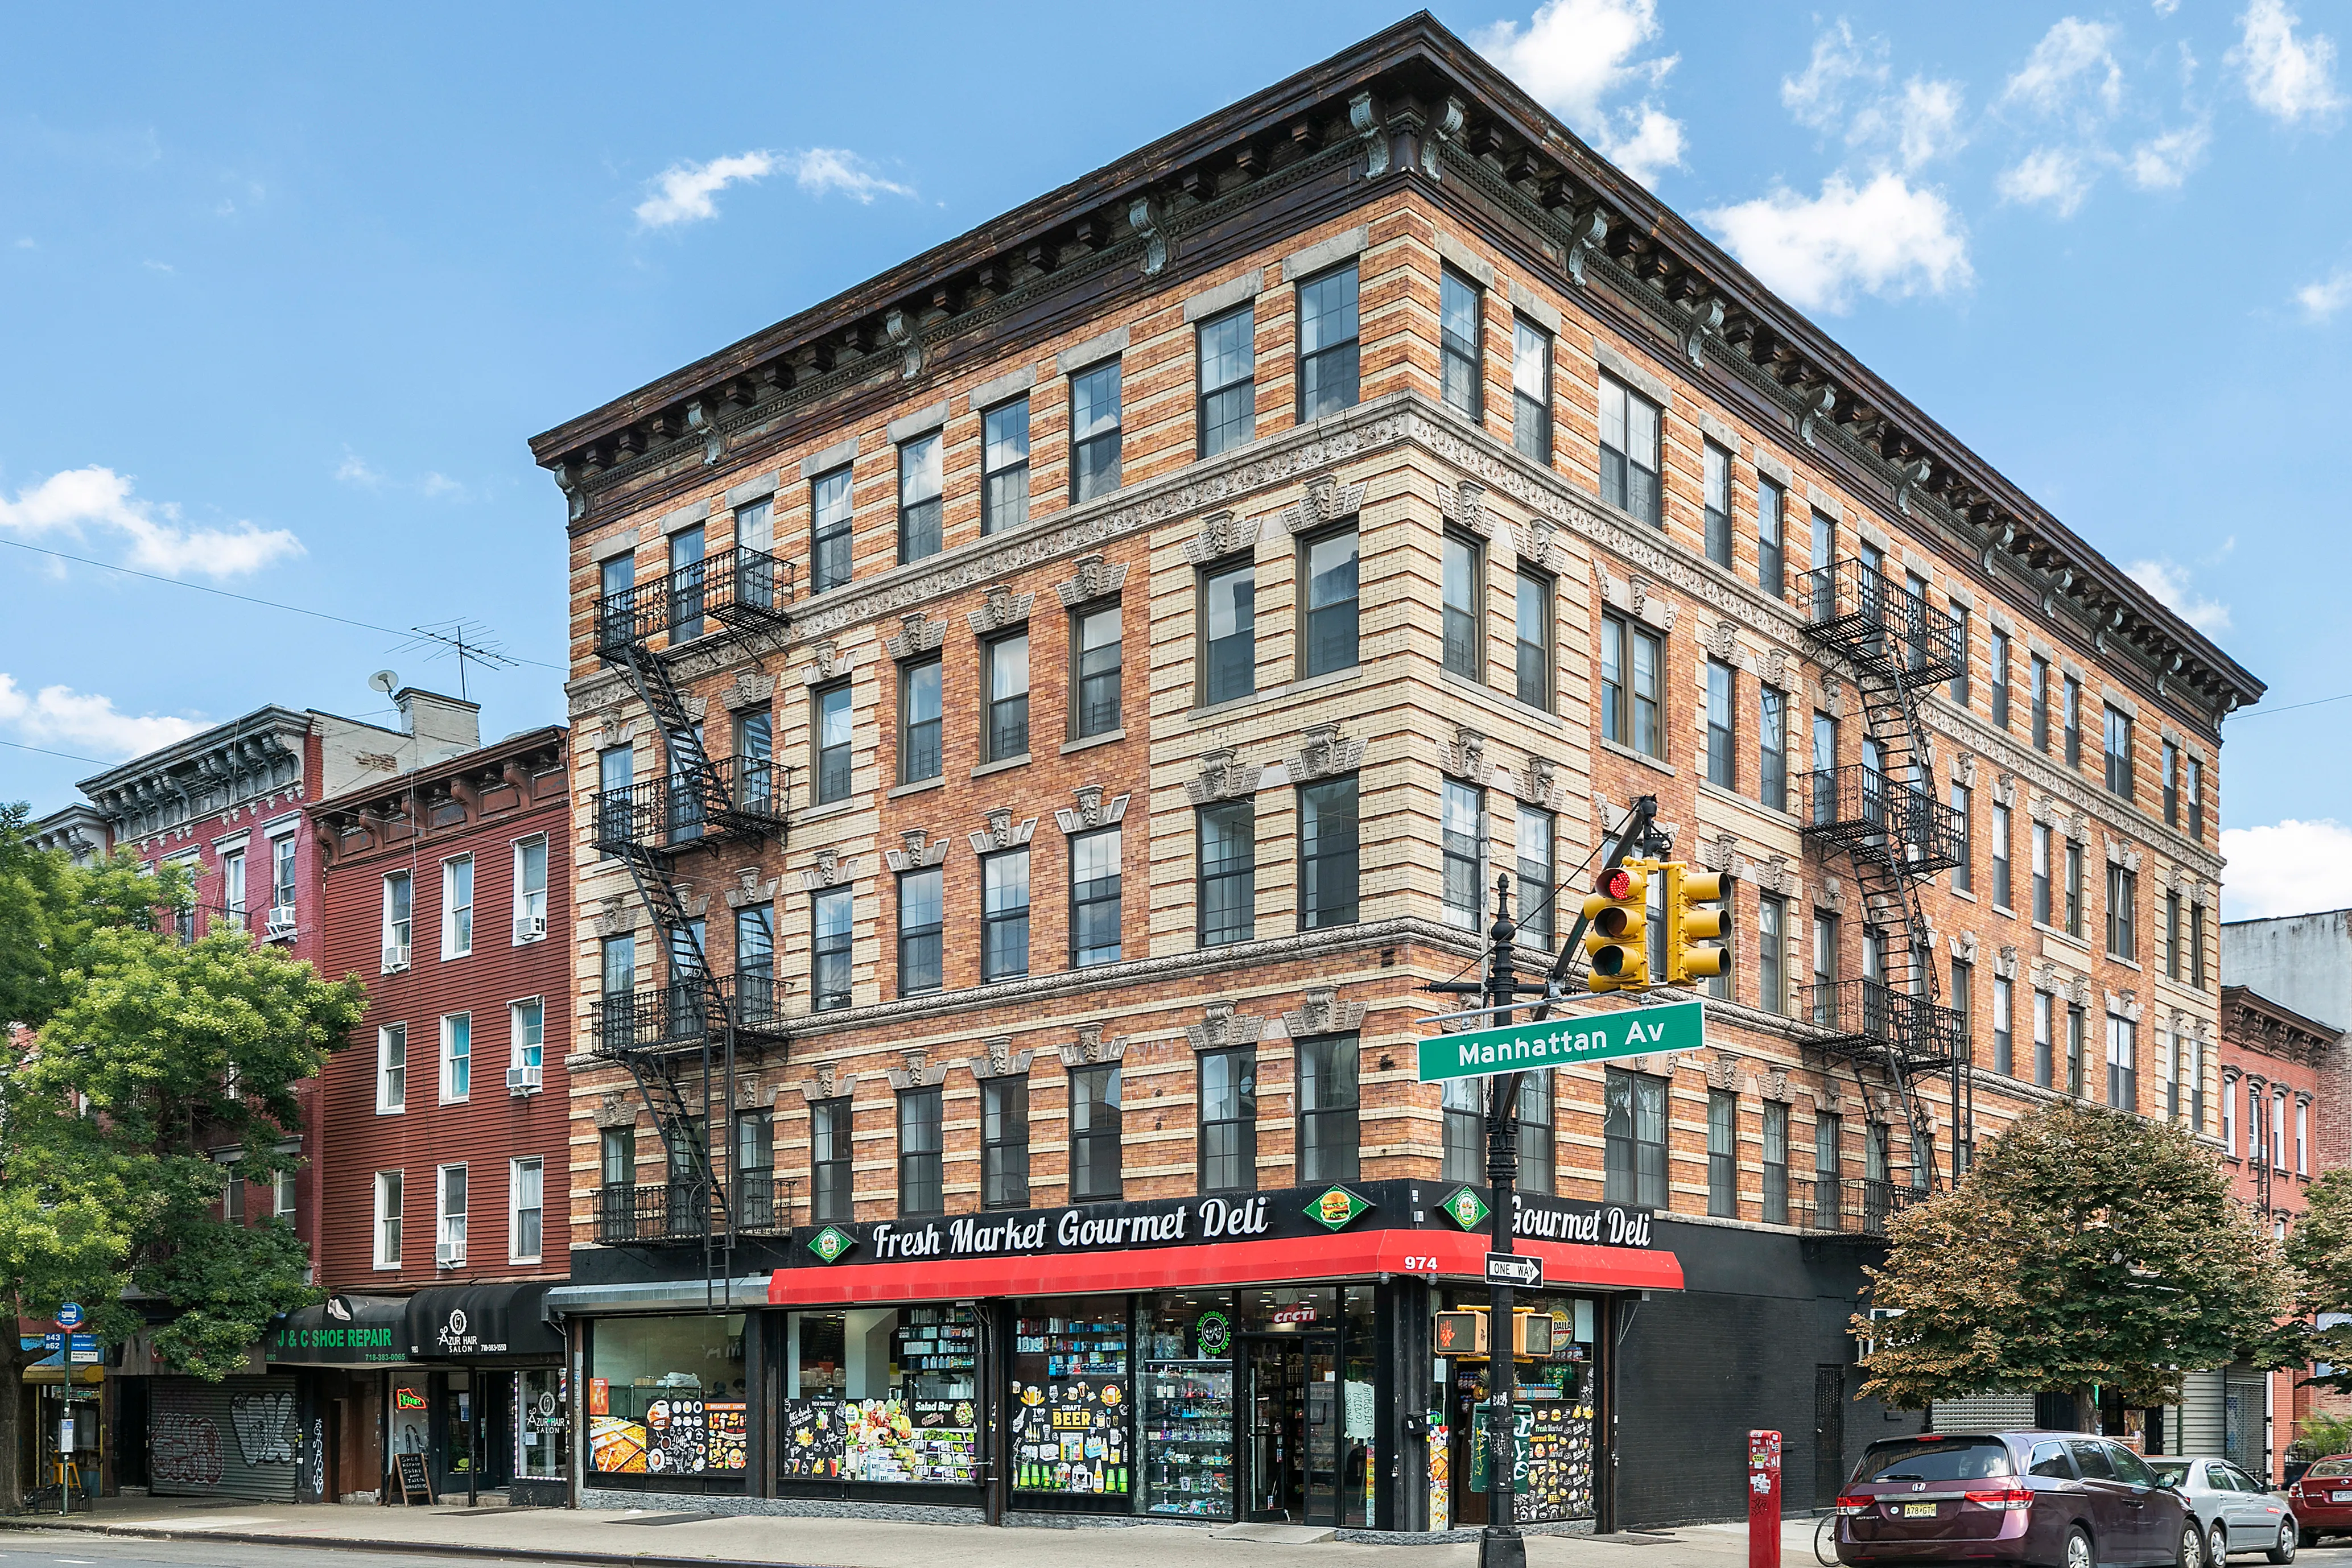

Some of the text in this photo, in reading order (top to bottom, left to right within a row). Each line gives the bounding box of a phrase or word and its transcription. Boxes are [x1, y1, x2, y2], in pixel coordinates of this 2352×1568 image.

[1459, 1021, 1665, 1066] Manhattan Av
[873, 1196, 1269, 1258] Fresh Market Gourmet Deli
[1607, 1207, 1650, 1247] Deli
[1405, 1256, 1438, 1270] 974
[1494, 1262, 1534, 1277] ONE WAY
[1196, 1311, 1229, 1332] TWO ROBBERS
[1274, 1310, 1315, 1323] CACTI
[1553, 1321, 1571, 1330] DALLA
[278, 1328, 391, 1347] J & C SHOE REPAIR
[437, 1330, 477, 1346] AZUR HAIR
[1198, 1331, 1231, 1354] HARD SELTZER
[481, 1343, 507, 1352] 718-383-1550
[399, 1393, 421, 1407] REPAIR
[915, 1401, 954, 1411] Salad Bar
[1363, 1388, 1373, 1426] HISPANA
[551, 1417, 564, 1426] HAIR
[1053, 1412, 1091, 1426] BEER
